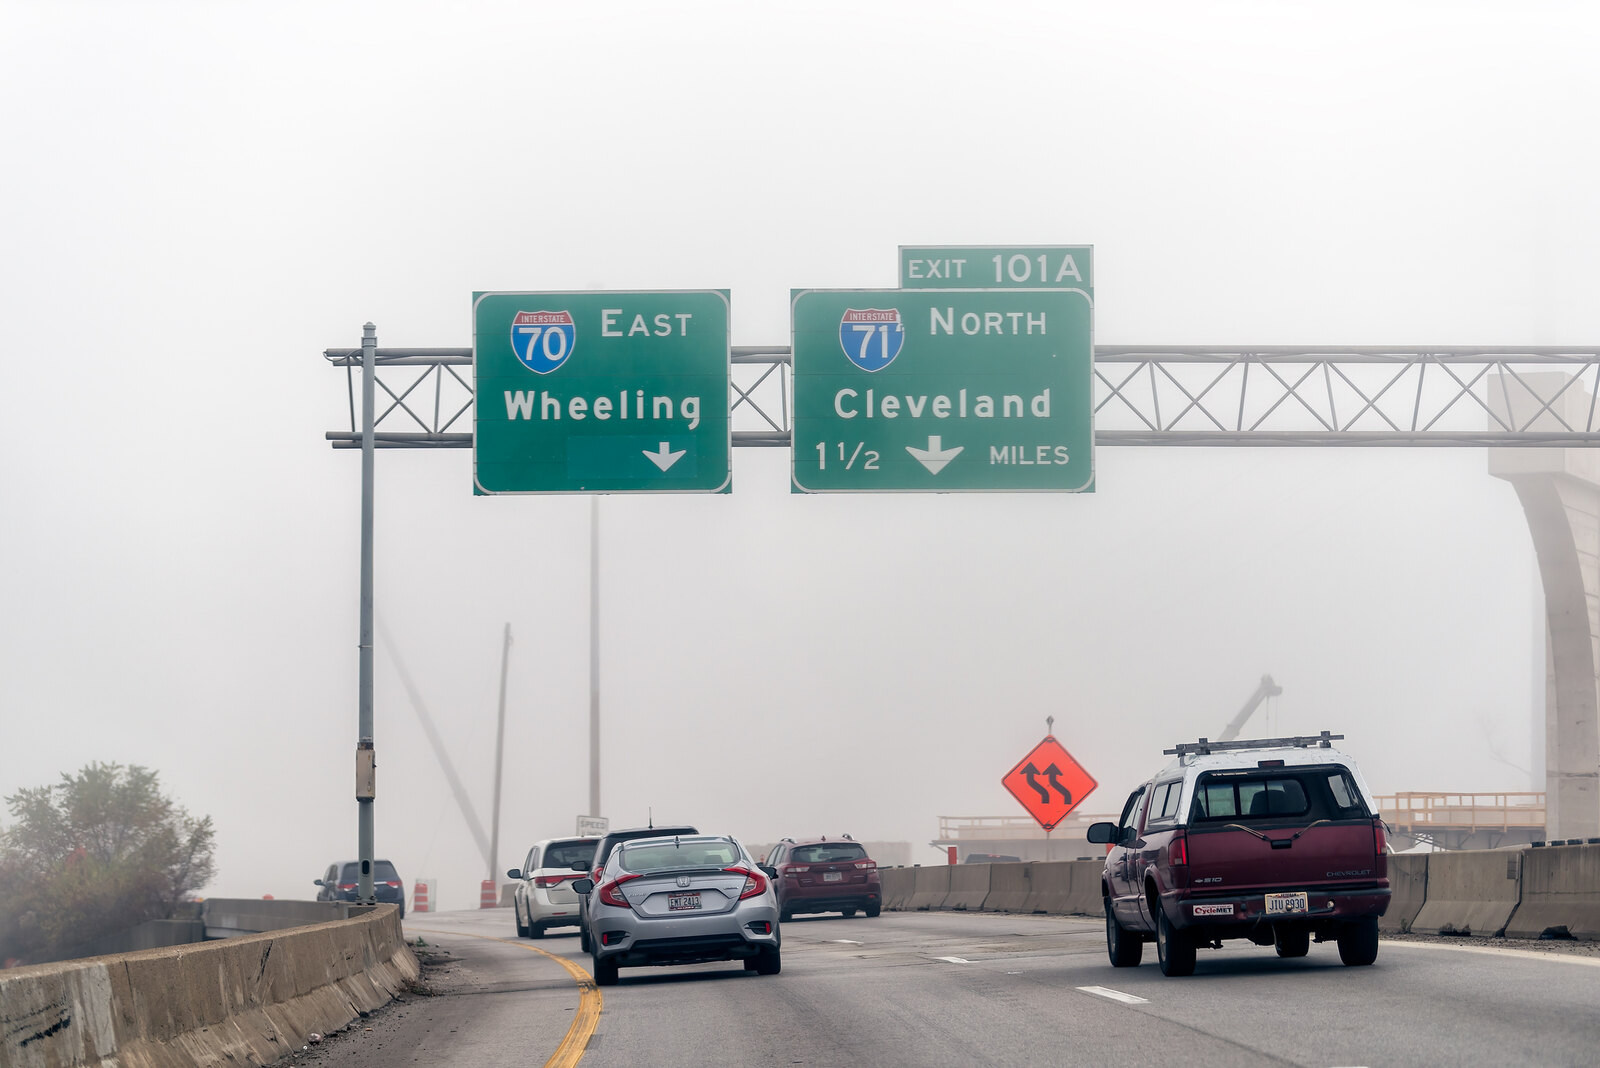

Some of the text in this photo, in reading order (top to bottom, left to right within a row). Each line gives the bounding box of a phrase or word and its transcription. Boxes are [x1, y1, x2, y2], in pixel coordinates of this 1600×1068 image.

[908, 254, 1083, 283] EXIT 101A
[521, 314, 565, 323] INTERSTATE
[601, 308, 693, 337] EAST
[849, 312, 894, 321] INTERSTATE
[930, 307, 1047, 335] NORTH
[518, 326, 567, 361] 70
[852, 324, 889, 359] 71
[503, 389, 701, 431] Wheeling
[834, 387, 1051, 419] Cleveland
[989, 445, 1070, 466] MILES
[1326, 869, 1372, 878] CHEVROLET
[683, 896, 699, 906] 2413
[1194, 906, 1232, 915] CycleMET
